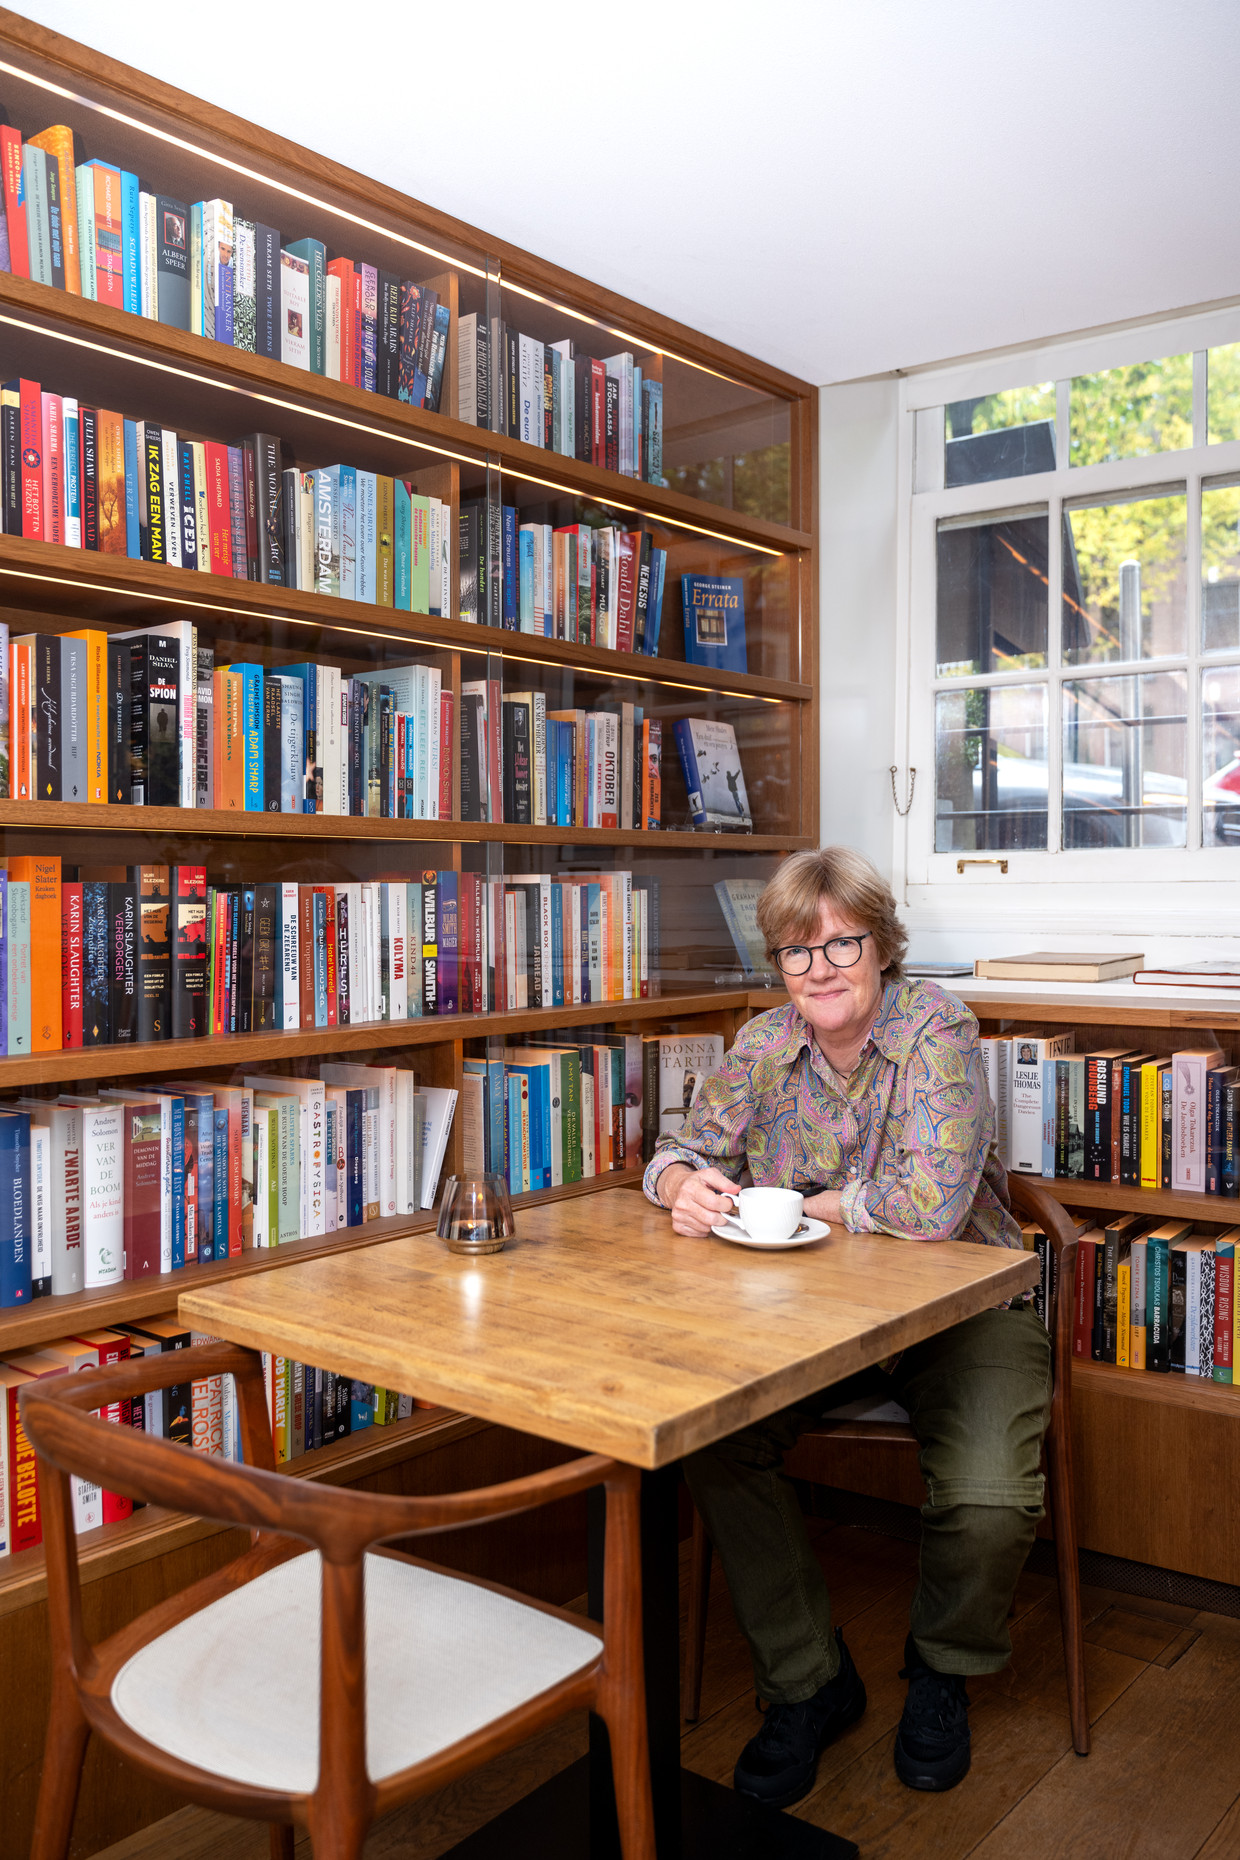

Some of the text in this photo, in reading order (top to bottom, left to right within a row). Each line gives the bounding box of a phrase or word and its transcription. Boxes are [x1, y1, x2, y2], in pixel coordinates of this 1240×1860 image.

[162, 249, 188, 262] ALBERT
[165, 257, 186, 270] SPEER
[224, 269, 232, 332] ANTIKANKER
[524, 400, 530, 414] De
[84, 417, 94, 445] JULIA
[86, 448, 95, 479] SHAW
[51, 472, 59, 518] GEHOORZAME
[148, 444, 163, 560] IK ZAG EEN MAN
[267, 443, 279, 563] THE MORAL ARC
[87, 502, 95, 541] KWAAD
[318, 471, 331, 593] AMSTERDAM
[619, 551, 632, 634] Roald Dahl
[638, 565, 650, 609] NEMESIS
[692, 589, 738, 608] Errata
[694, 582, 710, 590] GEORGE
[149, 655, 178, 663] DANIEL
[152, 661, 174, 669] SILVA
[150, 688, 176, 700] SPION
[197, 708, 208, 792] HOMICIDE
[249, 730, 259, 793] ADAM SHARP
[288, 713, 298, 782] De tijgerklauw
[605, 751, 615, 805] OKTOBER
[35, 864, 56, 874] Nigel
[35, 875, 57, 884] Slater
[10, 888, 18, 938] Skorobogatov
[97, 897, 105, 926] KARIN
[88, 917, 96, 964] Zoenoffer
[260, 917, 270, 937] GEEK
[70, 895, 80, 1009] KARIN SLAUGHTER
[115, 912, 124, 981] VERBORGEN
[125, 896, 133, 995] KARIN SLAUGHTER
[259, 939, 270, 952] GIRL
[394, 938, 403, 980] KOLYMA
[424, 889, 436, 1002] WILBUR SMITH
[662, 1044, 716, 1055] DONNA
[662, 1055, 716, 1068] TARTT
[1013, 1080, 1042, 1089] THOMAS
[1015, 1071, 1039, 1080] LESLIE
[1088, 1060, 1098, 1110] THUNBERG
[1097, 1060, 1106, 1104] ROSLUND
[1181, 1101, 1187, 1110] De
[92, 1129, 118, 1137] Solomon
[94, 1118, 116, 1126] Andrew
[97, 1142, 115, 1152] VER
[97, 1156, 116, 1166] VAN
[134, 1146, 159, 1154] DEMONEN
[313, 1101, 321, 1219] GASTROFYSICA
[91, 1183, 120, 1195] BOOM
[101, 1170, 113, 1180] DE
[64, 1149, 80, 1251] ZWARTE AARDE
[13, 1178, 24, 1263] BLOEDLANDEN
[93, 1211, 114, 1219] anders
[1107, 1273, 1112, 1282] OF
[1219, 1265, 1229, 1320] WISDOM RISING
[175, 1342, 183, 1350] M
[276, 1354, 285, 1428] OB MARLEY
[209, 1377, 222, 1455] PATRICK
[16, 1460, 37, 1527] BELOFTE
[82, 1493, 97, 1505] SMITH
